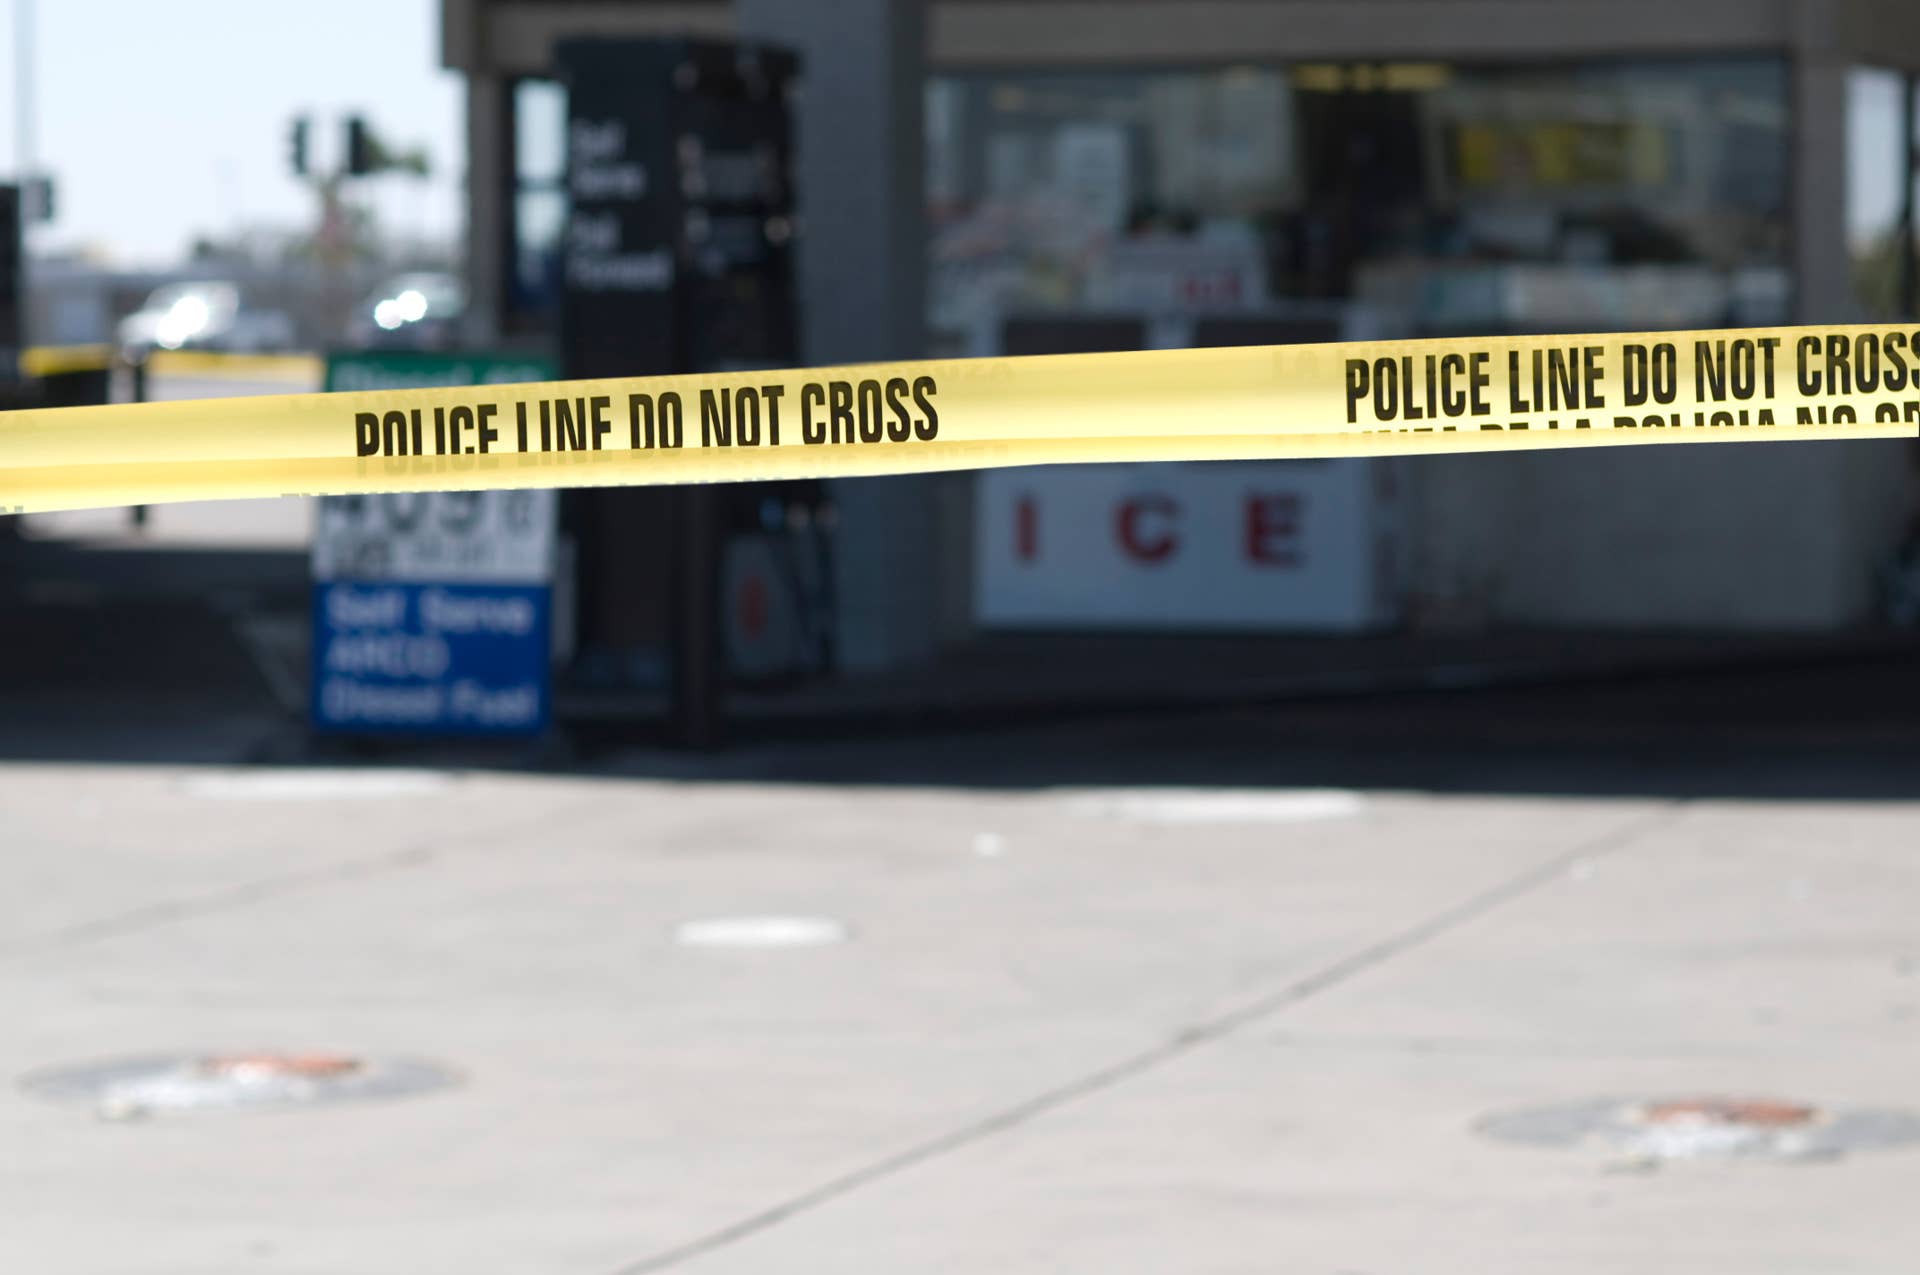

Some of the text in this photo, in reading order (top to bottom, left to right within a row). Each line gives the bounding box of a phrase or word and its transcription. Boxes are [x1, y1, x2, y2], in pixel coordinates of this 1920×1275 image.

[355, 375, 939, 457] POLICE LINE DO NOT CROSS
[1346, 352, 1491, 423] POLICE
[1508, 346, 1605, 414] LINE
[1623, 342, 1677, 406] DO
[1694, 337, 1781, 402] NOT
[1014, 492, 1306, 568] ICE
